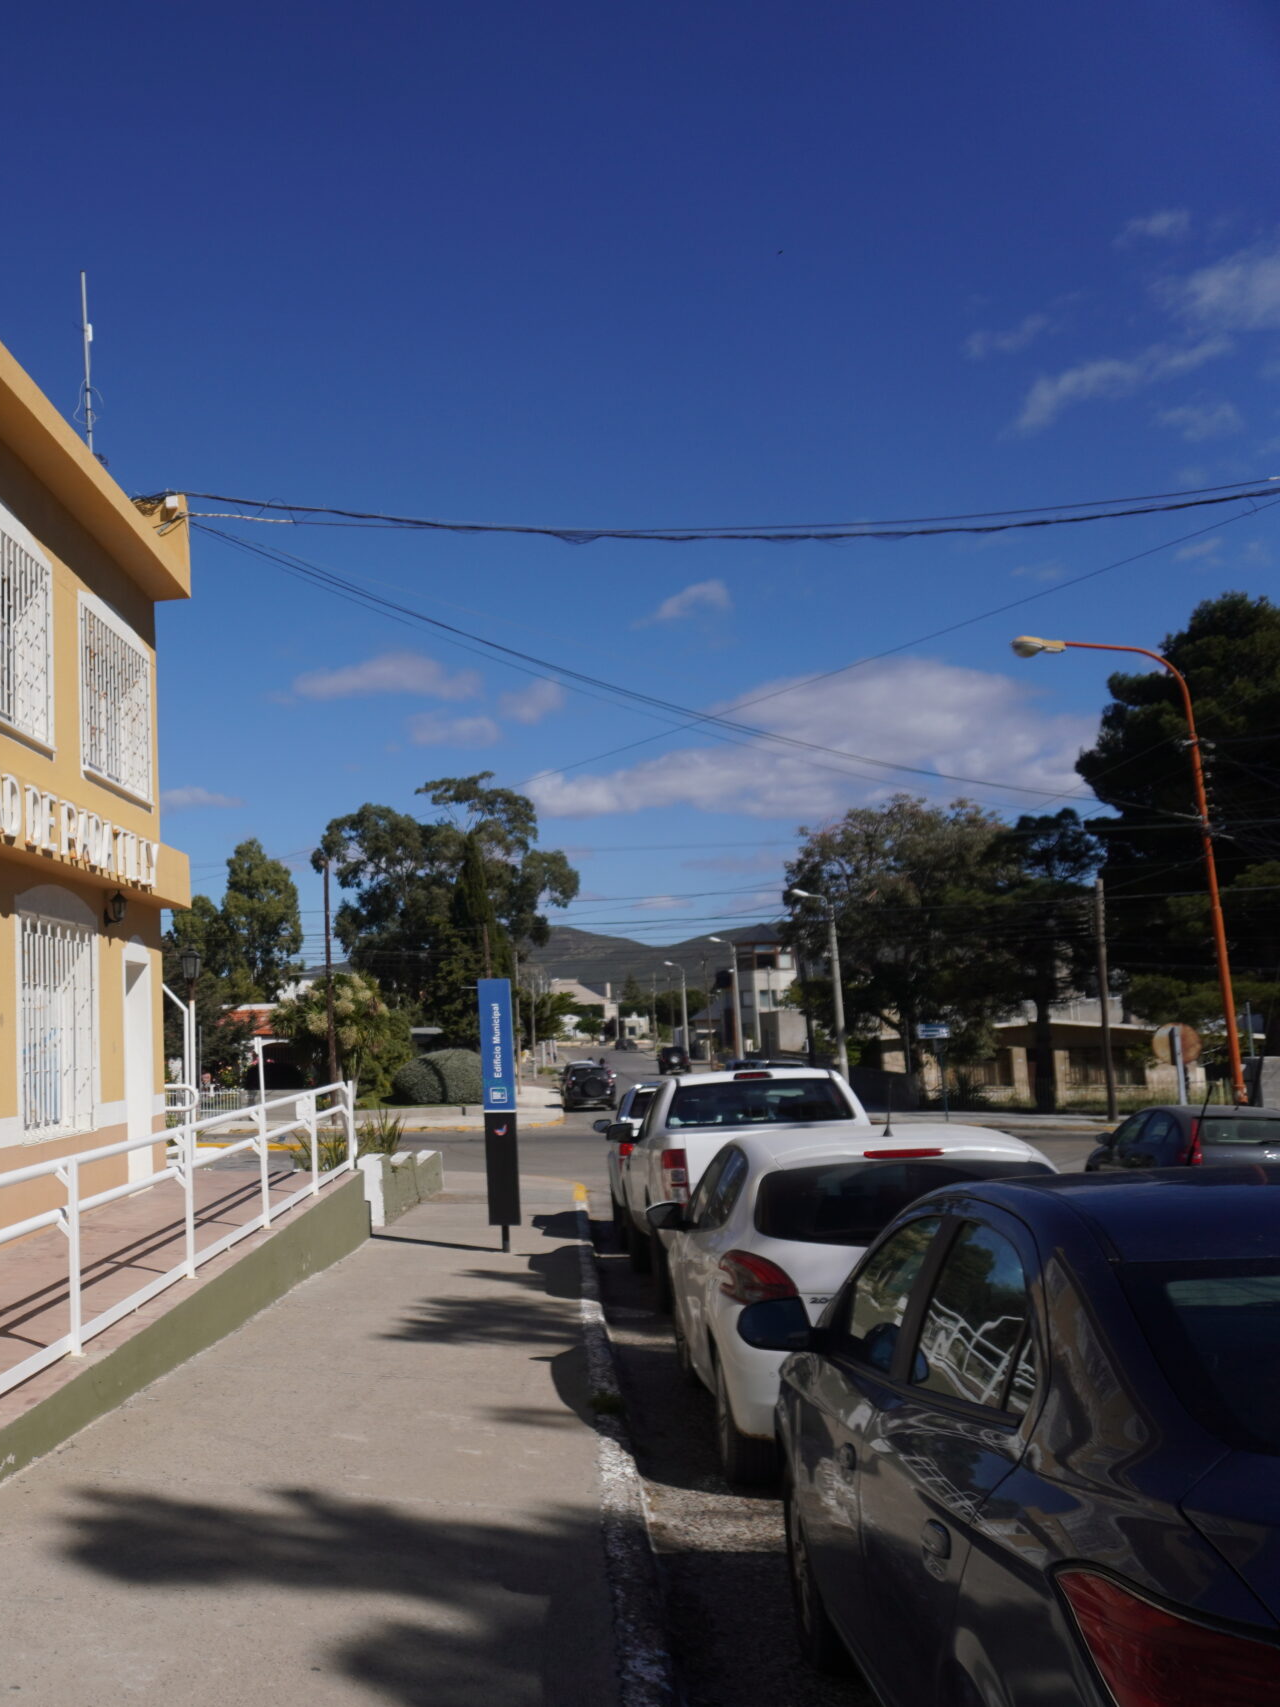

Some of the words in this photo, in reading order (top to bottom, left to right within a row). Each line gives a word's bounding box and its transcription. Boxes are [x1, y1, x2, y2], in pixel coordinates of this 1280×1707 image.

[24, 784, 58, 852] DE
[491, 1003, 502, 1044] Municipal
[493, 1045, 502, 1078] Edificio
